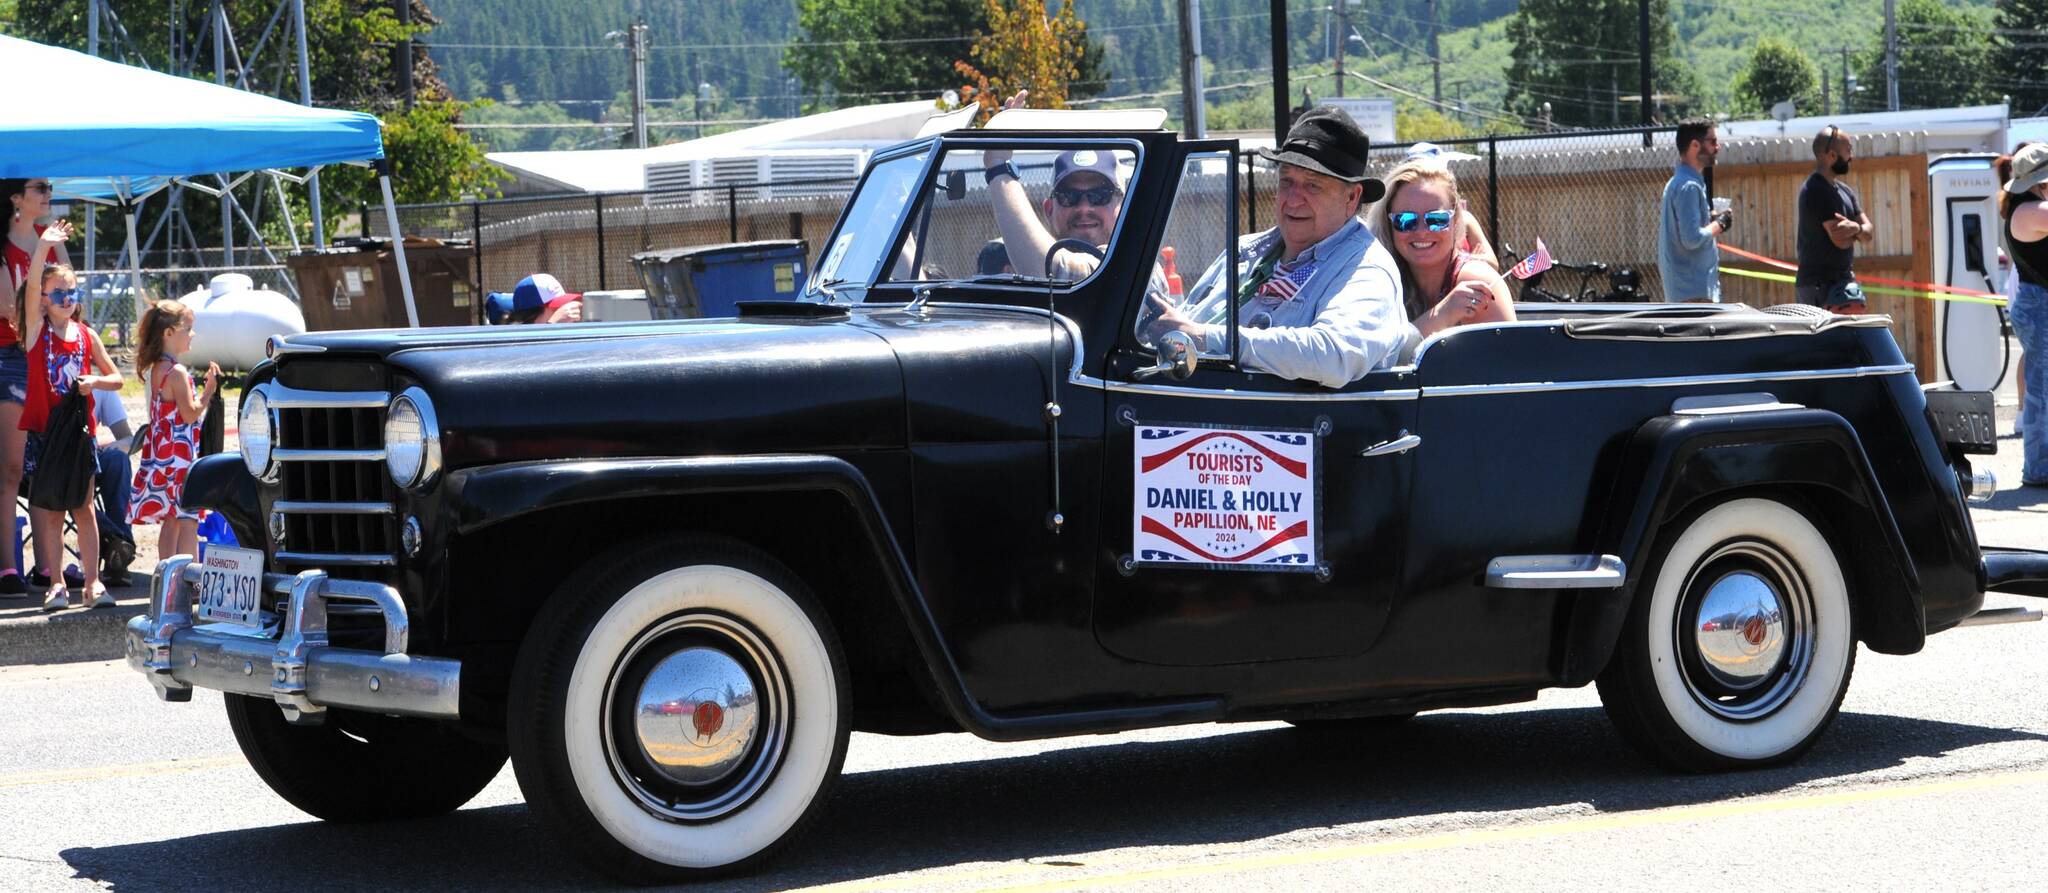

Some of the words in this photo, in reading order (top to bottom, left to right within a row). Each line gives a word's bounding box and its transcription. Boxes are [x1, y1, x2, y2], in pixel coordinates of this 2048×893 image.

[1187, 452, 1264, 473] TOURISTS
[1198, 473, 1209, 485] OF
[1213, 474, 1230, 485] THE
[1232, 475, 1252, 486] DAY
[1147, 487, 1217, 510] DANIEL
[1222, 490, 1237, 511] &
[1242, 491, 1302, 512] HOLLY
[1174, 512, 1254, 533] PAPILLION,
[1257, 515, 1277, 531] NE
[1215, 533, 1236, 542] 2024
[206, 556, 240, 570] WASHINGTON
